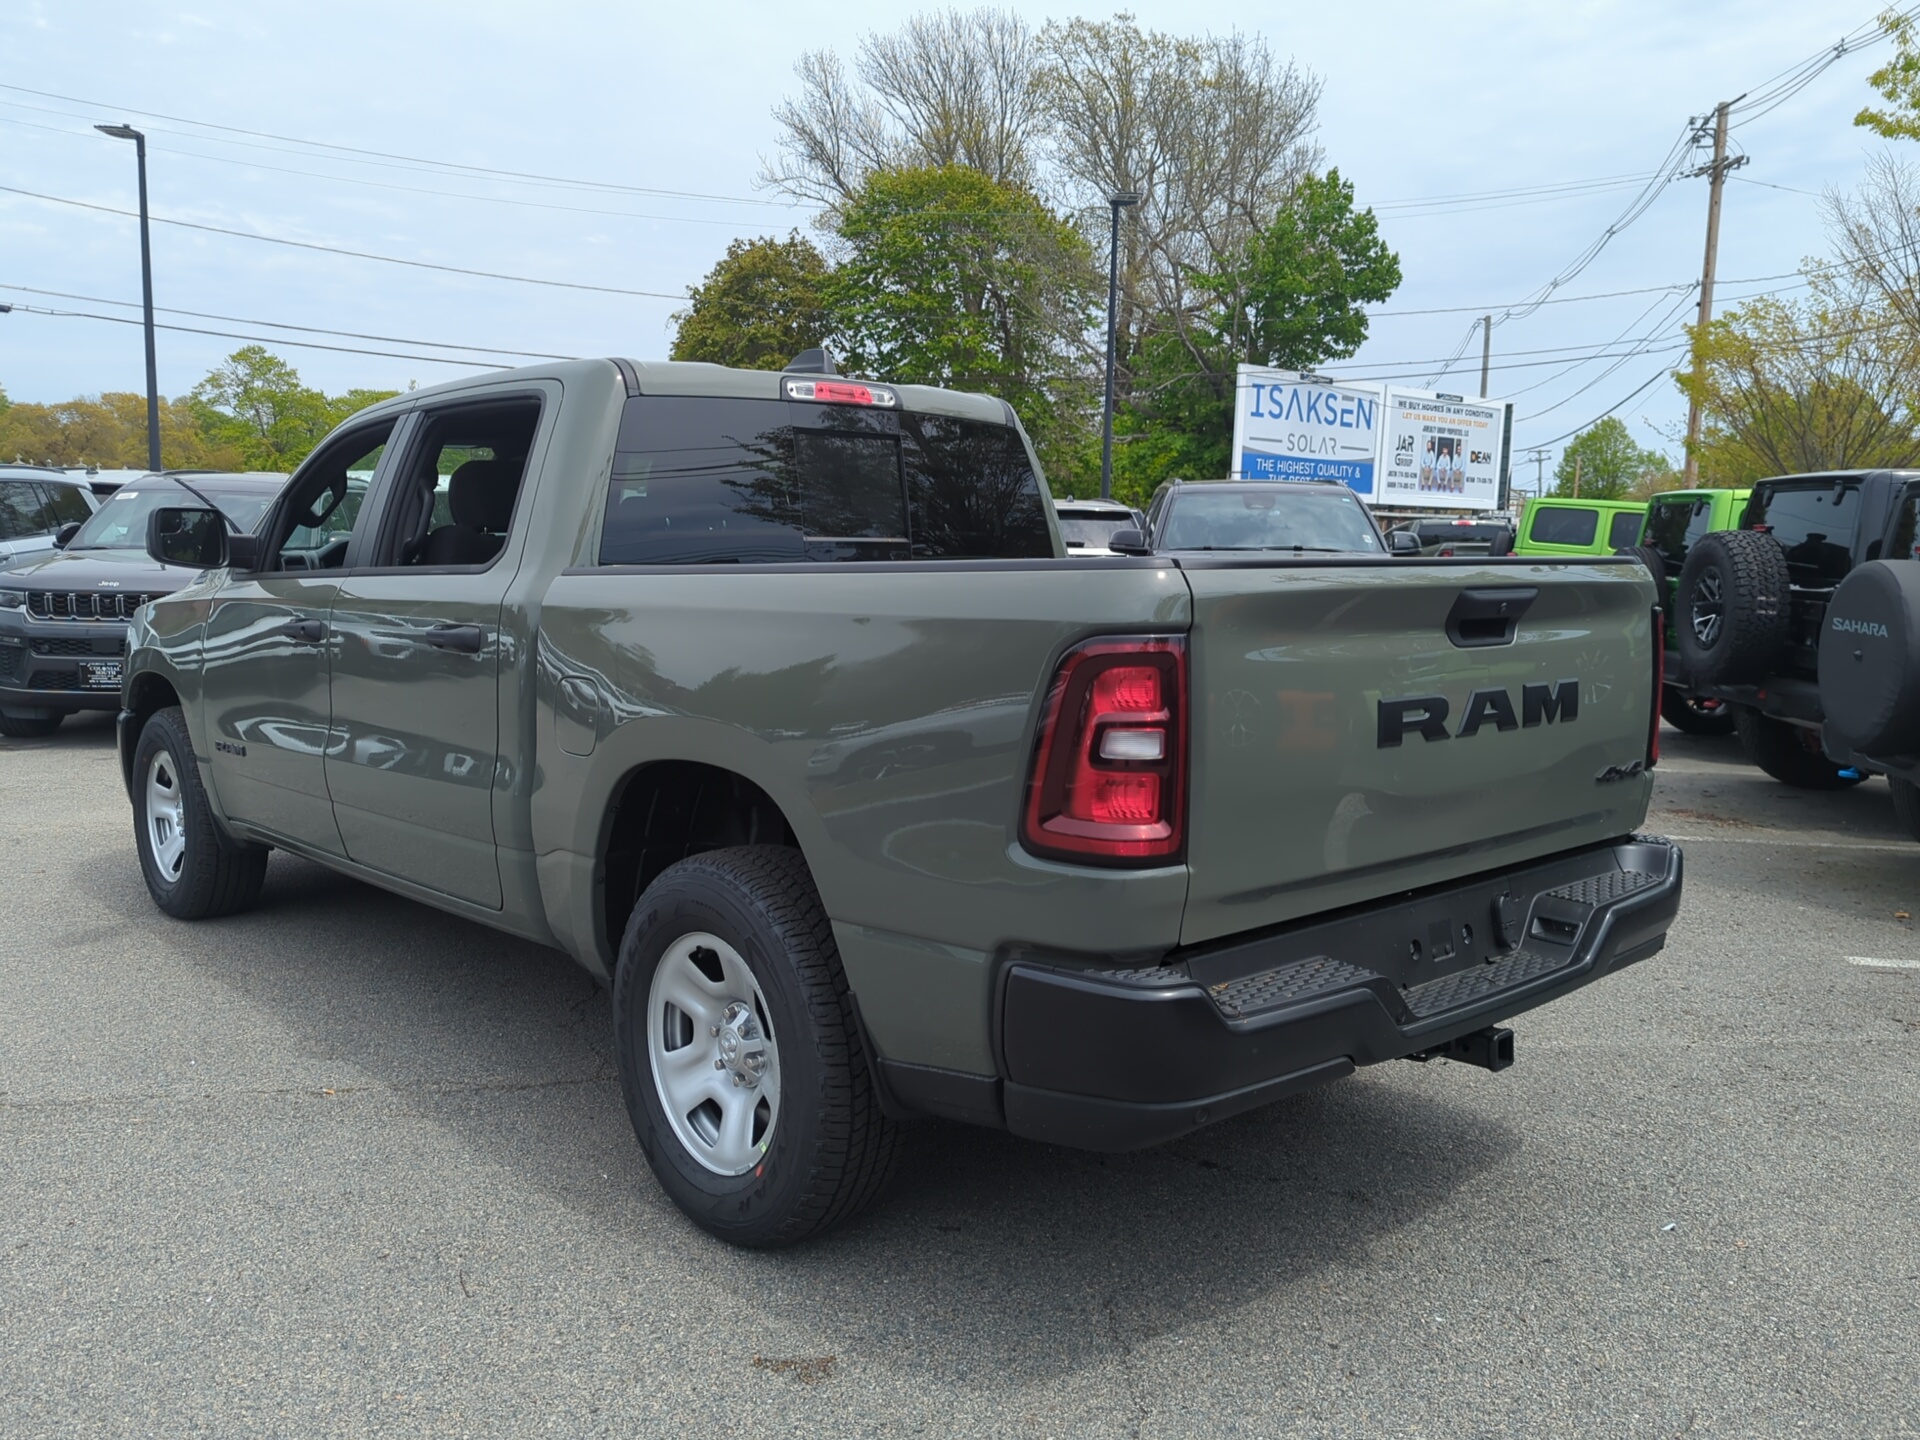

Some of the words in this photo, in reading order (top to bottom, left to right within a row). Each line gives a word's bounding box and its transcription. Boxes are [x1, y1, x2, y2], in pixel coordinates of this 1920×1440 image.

[1250, 383, 1373, 430] ISAKSEN
[1398, 400, 1407, 408] WE
[1409, 401, 1420, 409] BUY
[1422, 402, 1444, 413] HOUSES
[1445, 406, 1452, 414] IN
[1453, 407, 1464, 415] ANY
[1465, 409, 1494, 419] CONDITION
[1287, 433, 1337, 455] SOLAR
[1396, 434, 1414, 452] JAR
[1470, 450, 1492, 464] DEAN
[1256, 458, 1275, 471] THE
[1277, 460, 1315, 475] HIGHEST
[1317, 463, 1353, 478] QUALITY
[1355, 466, 1361, 479] &
[1832, 617, 1888, 638] SAHARA
[1377, 677, 1579, 749] RAM
